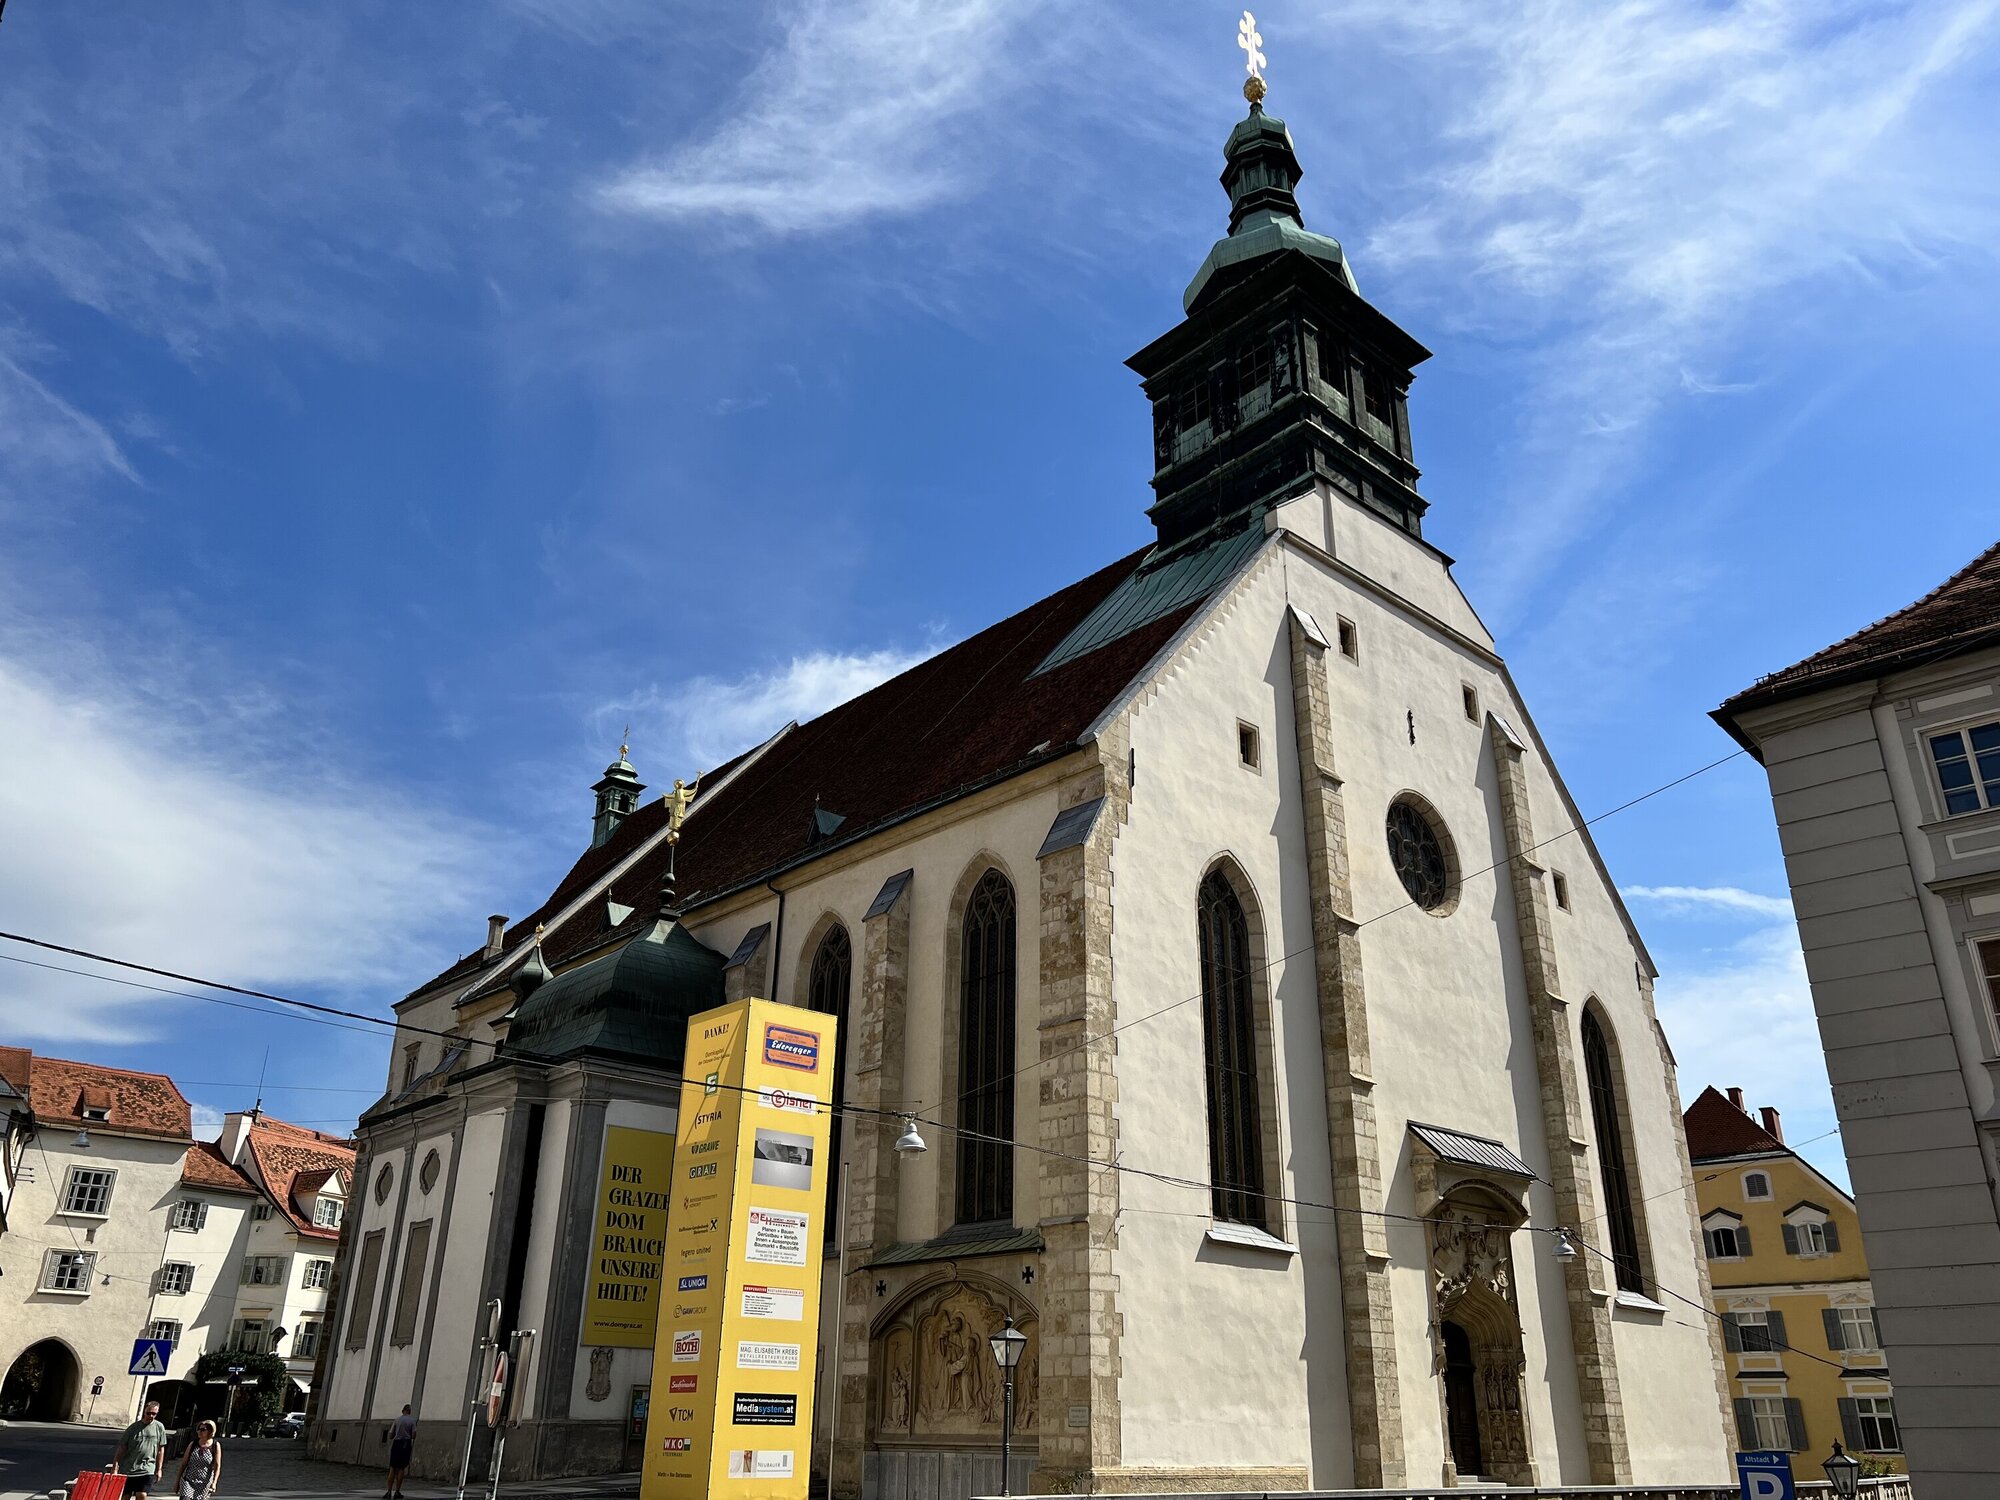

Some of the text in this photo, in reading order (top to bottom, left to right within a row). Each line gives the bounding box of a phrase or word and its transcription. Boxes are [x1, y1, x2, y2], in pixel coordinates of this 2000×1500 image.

[704, 1023, 730, 1040] DANKE!
[771, 1040, 812, 1056] Ederegger
[699, 1140, 720, 1154] GRAWE
[611, 1164, 642, 1184] DER
[690, 1163, 717, 1179] GRAZ
[606, 1210, 646, 1231] DOM
[602, 1234, 664, 1256] BRAUCH
[601, 1258, 660, 1280] UNSERE
[688, 1278, 706, 1288] UNIQA
[597, 1282, 648, 1302] HILFE!
[593, 1321, 643, 1329] www.domgraz.at
[675, 1341, 698, 1353] ROTH
[754, 1347, 781, 1355] ELISABETH
[781, 1348, 798, 1356] KREBS
[678, 1409, 694, 1422] TCM
[736, 1403, 794, 1414] Mediasystem.at
[664, 1438, 683, 1450] WKO
[1744, 1455, 1770, 1463] Altstadt
[1746, 1471, 1784, 1500] P
